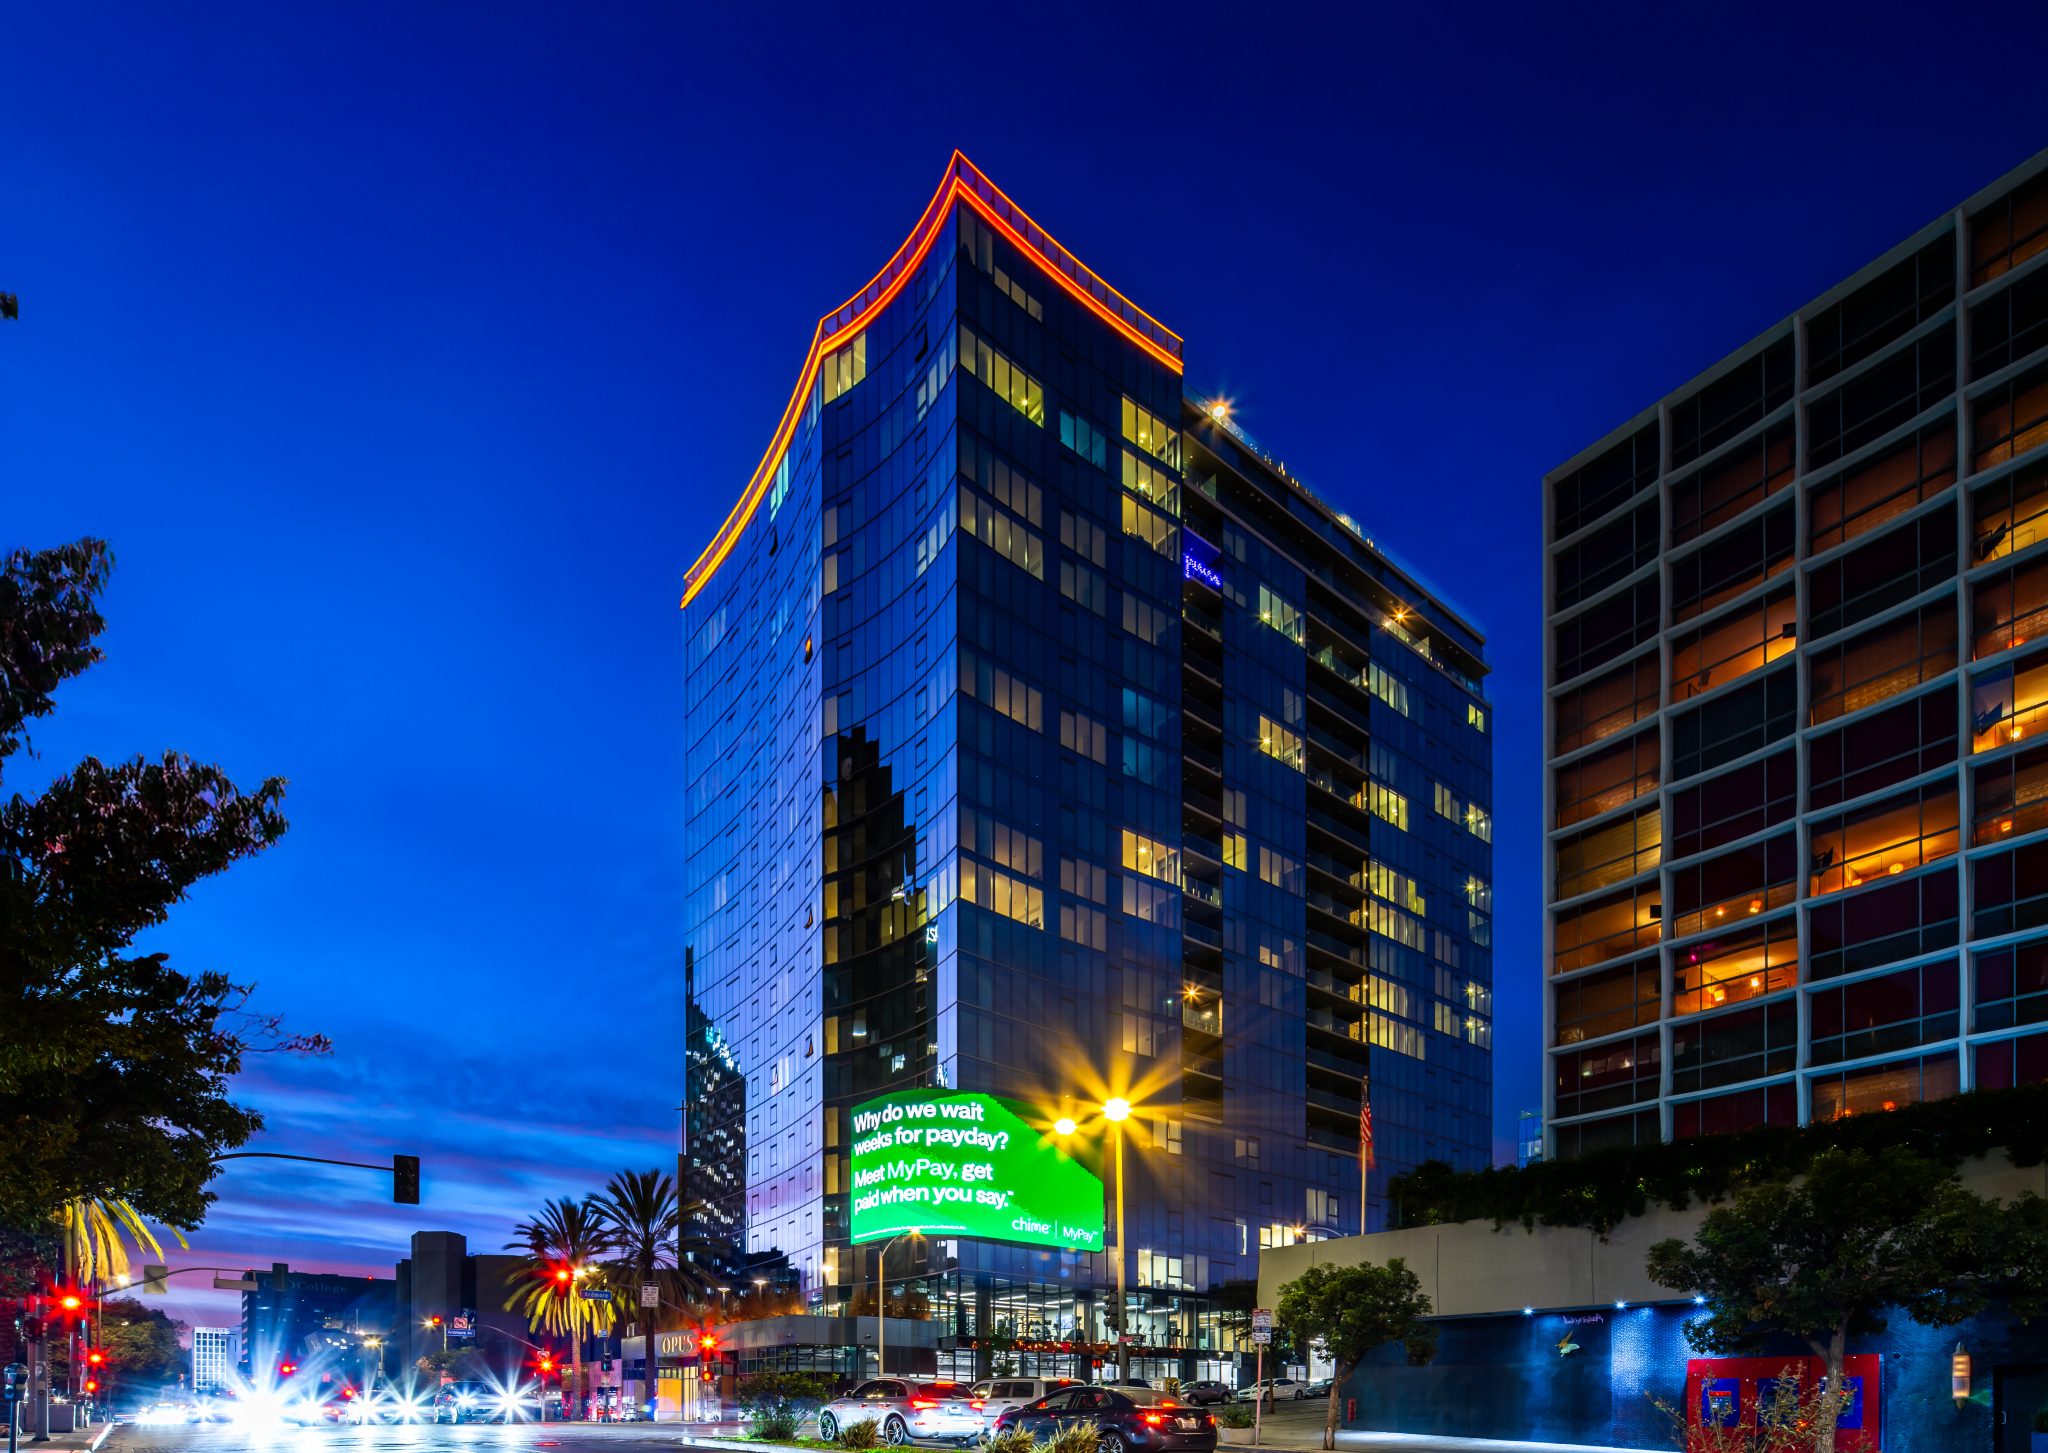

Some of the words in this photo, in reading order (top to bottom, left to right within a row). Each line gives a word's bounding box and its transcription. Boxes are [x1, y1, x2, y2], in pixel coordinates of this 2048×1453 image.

[853, 1111, 881, 1134] Why
[882, 1103, 904, 1123] do
[905, 1104, 937, 1119] we
[939, 1101, 985, 1122] wait
[853, 1131, 893, 1157] weeks
[894, 1126, 923, 1145] for
[925, 1126, 1009, 1152] payday?
[854, 1164, 886, 1189] Meet
[887, 1158, 958, 1182] MyPay,
[961, 1162, 994, 1182] get
[854, 1188, 880, 1217] paid
[880, 1185, 930, 1205] when
[932, 1187, 973, 1205] you
[1011, 1216, 1051, 1235] chime
[662, 1335, 693, 1353] OPUS
